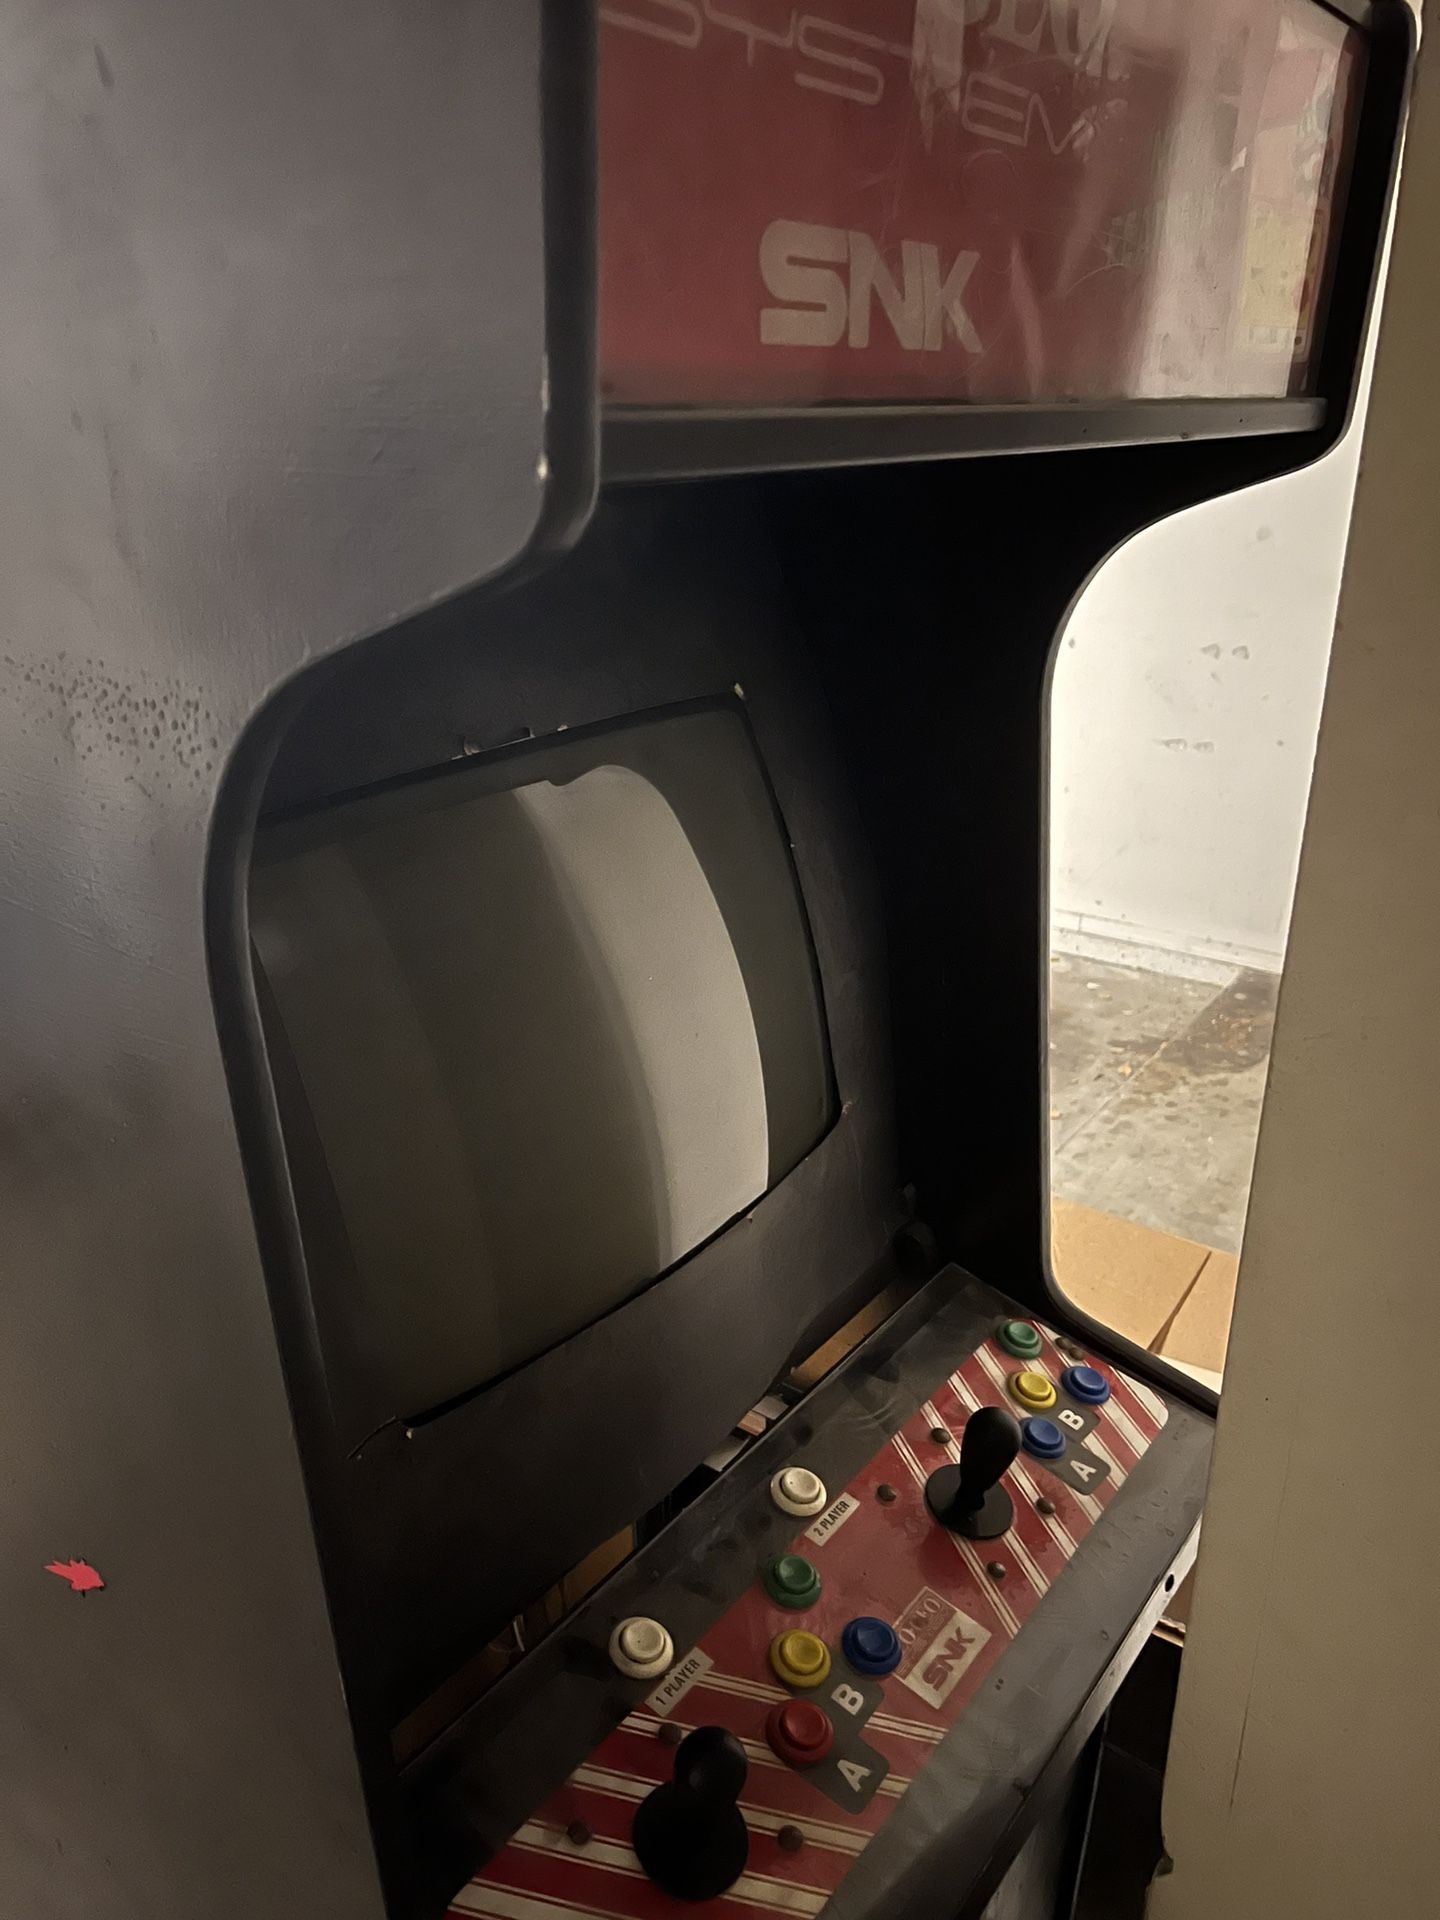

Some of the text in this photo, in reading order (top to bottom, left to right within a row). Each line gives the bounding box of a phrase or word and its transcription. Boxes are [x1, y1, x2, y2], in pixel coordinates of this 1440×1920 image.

[759, 218, 985, 354] SNK
[1057, 1409, 1085, 1431] B
[1070, 1459, 1097, 1483] A
[813, 1500, 850, 1537] 2 PLAYER
[922, 1626, 976, 1692] SNK
[655, 1658, 701, 1706] 1 PLAYER
[831, 1683, 864, 1716] B
[836, 1759, 872, 1793] A
